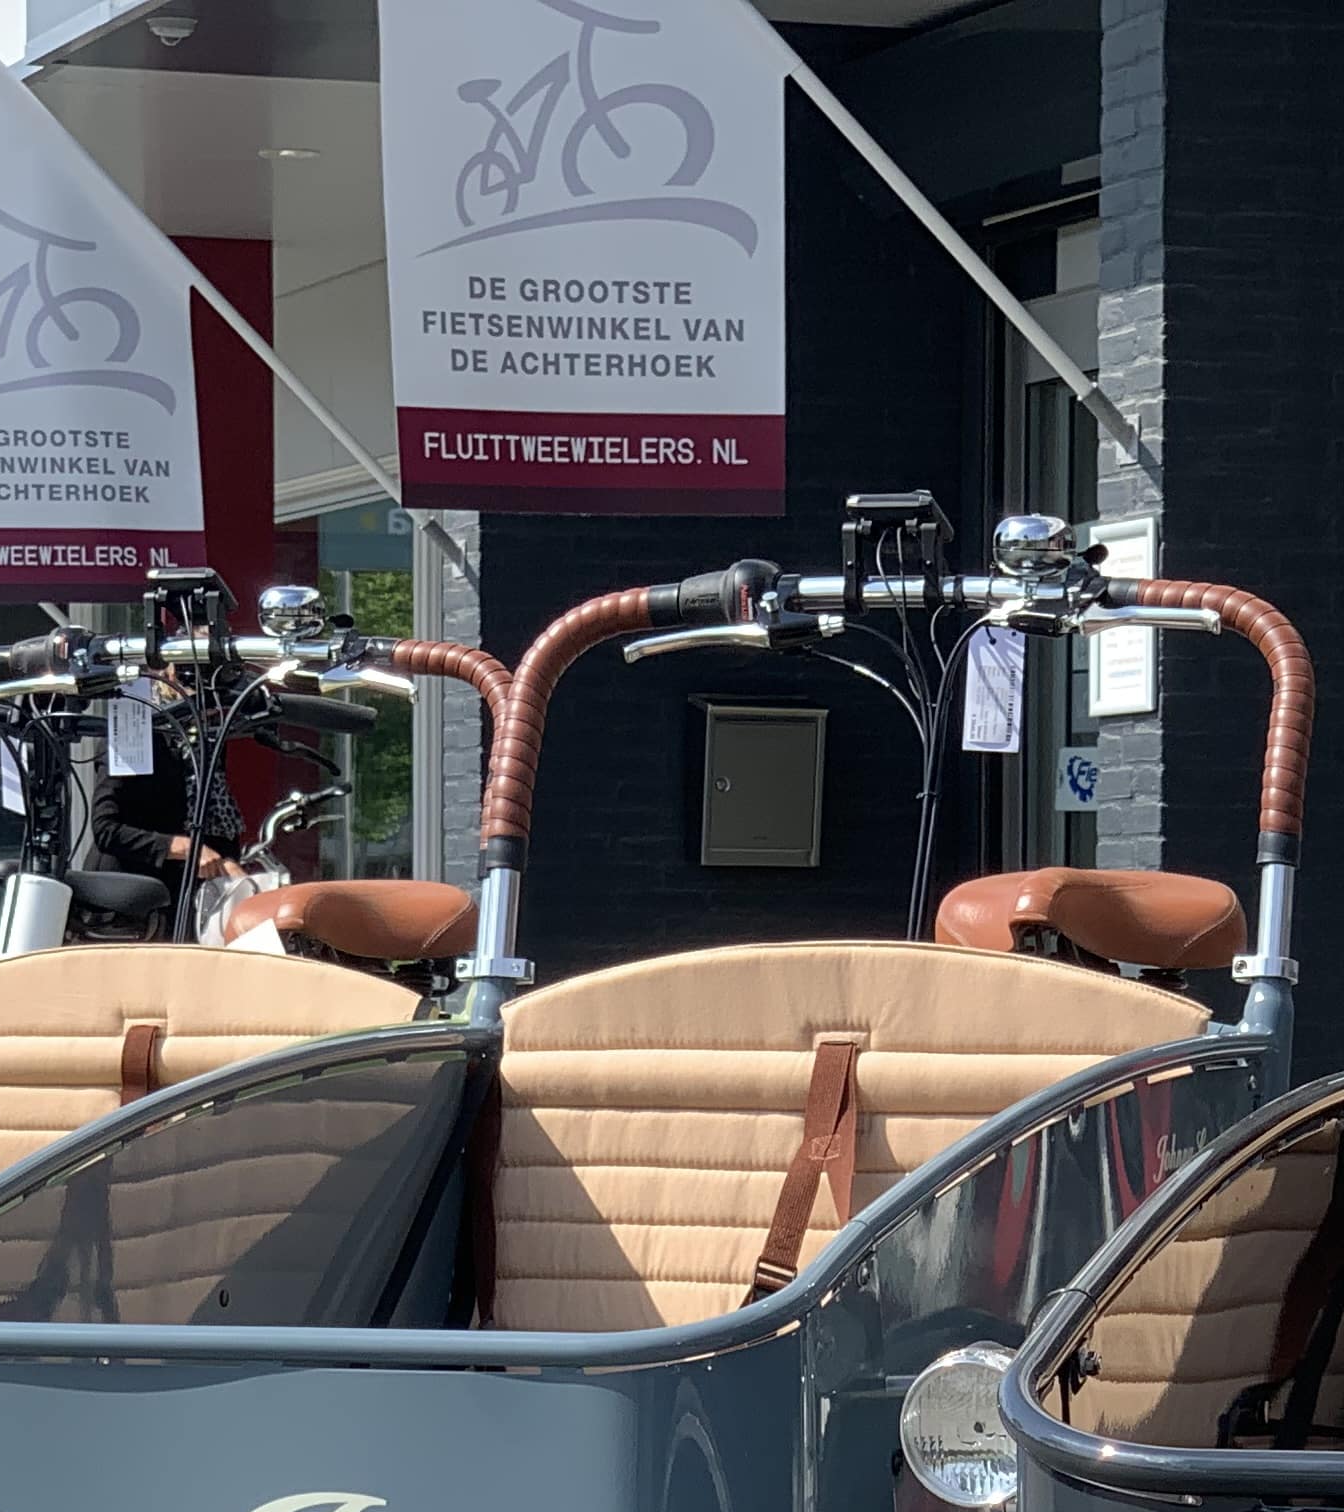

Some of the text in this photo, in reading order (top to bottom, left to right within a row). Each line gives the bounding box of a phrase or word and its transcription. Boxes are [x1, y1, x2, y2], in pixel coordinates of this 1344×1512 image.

[468, 276, 693, 305] DE GROOTSTE
[422, 311, 745, 342] FIETSENWINKEL VAN
[450, 348, 717, 378] DE ACHTERHOEK
[123, 458, 171, 477] VAN
